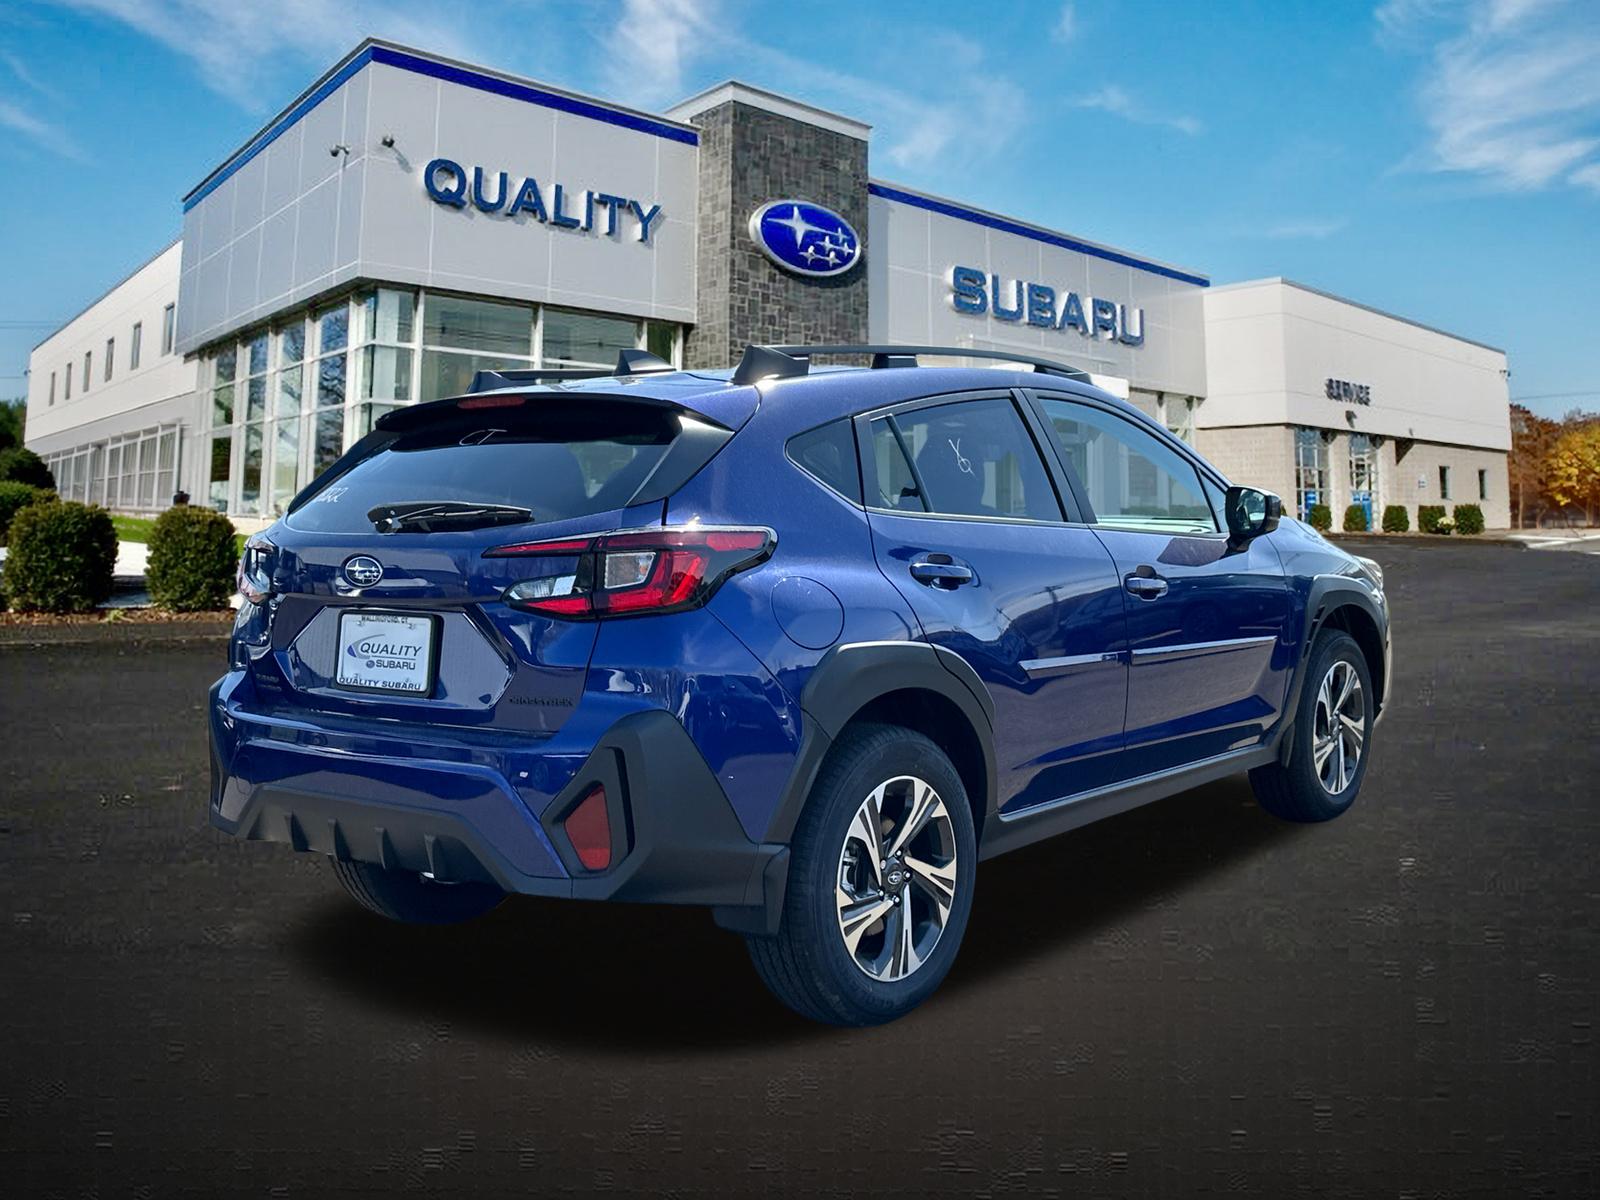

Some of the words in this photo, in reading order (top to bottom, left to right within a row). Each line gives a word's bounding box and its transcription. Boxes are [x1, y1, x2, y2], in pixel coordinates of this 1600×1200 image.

[424, 158, 662, 242] QUALITY
[950, 265, 1145, 347] SUBARU
[360, 642, 422, 657] QUALITY
[375, 659, 416, 670] SUBARU
[339, 677, 379, 687] QUALITY
[381, 680, 421, 690] SUBARU
